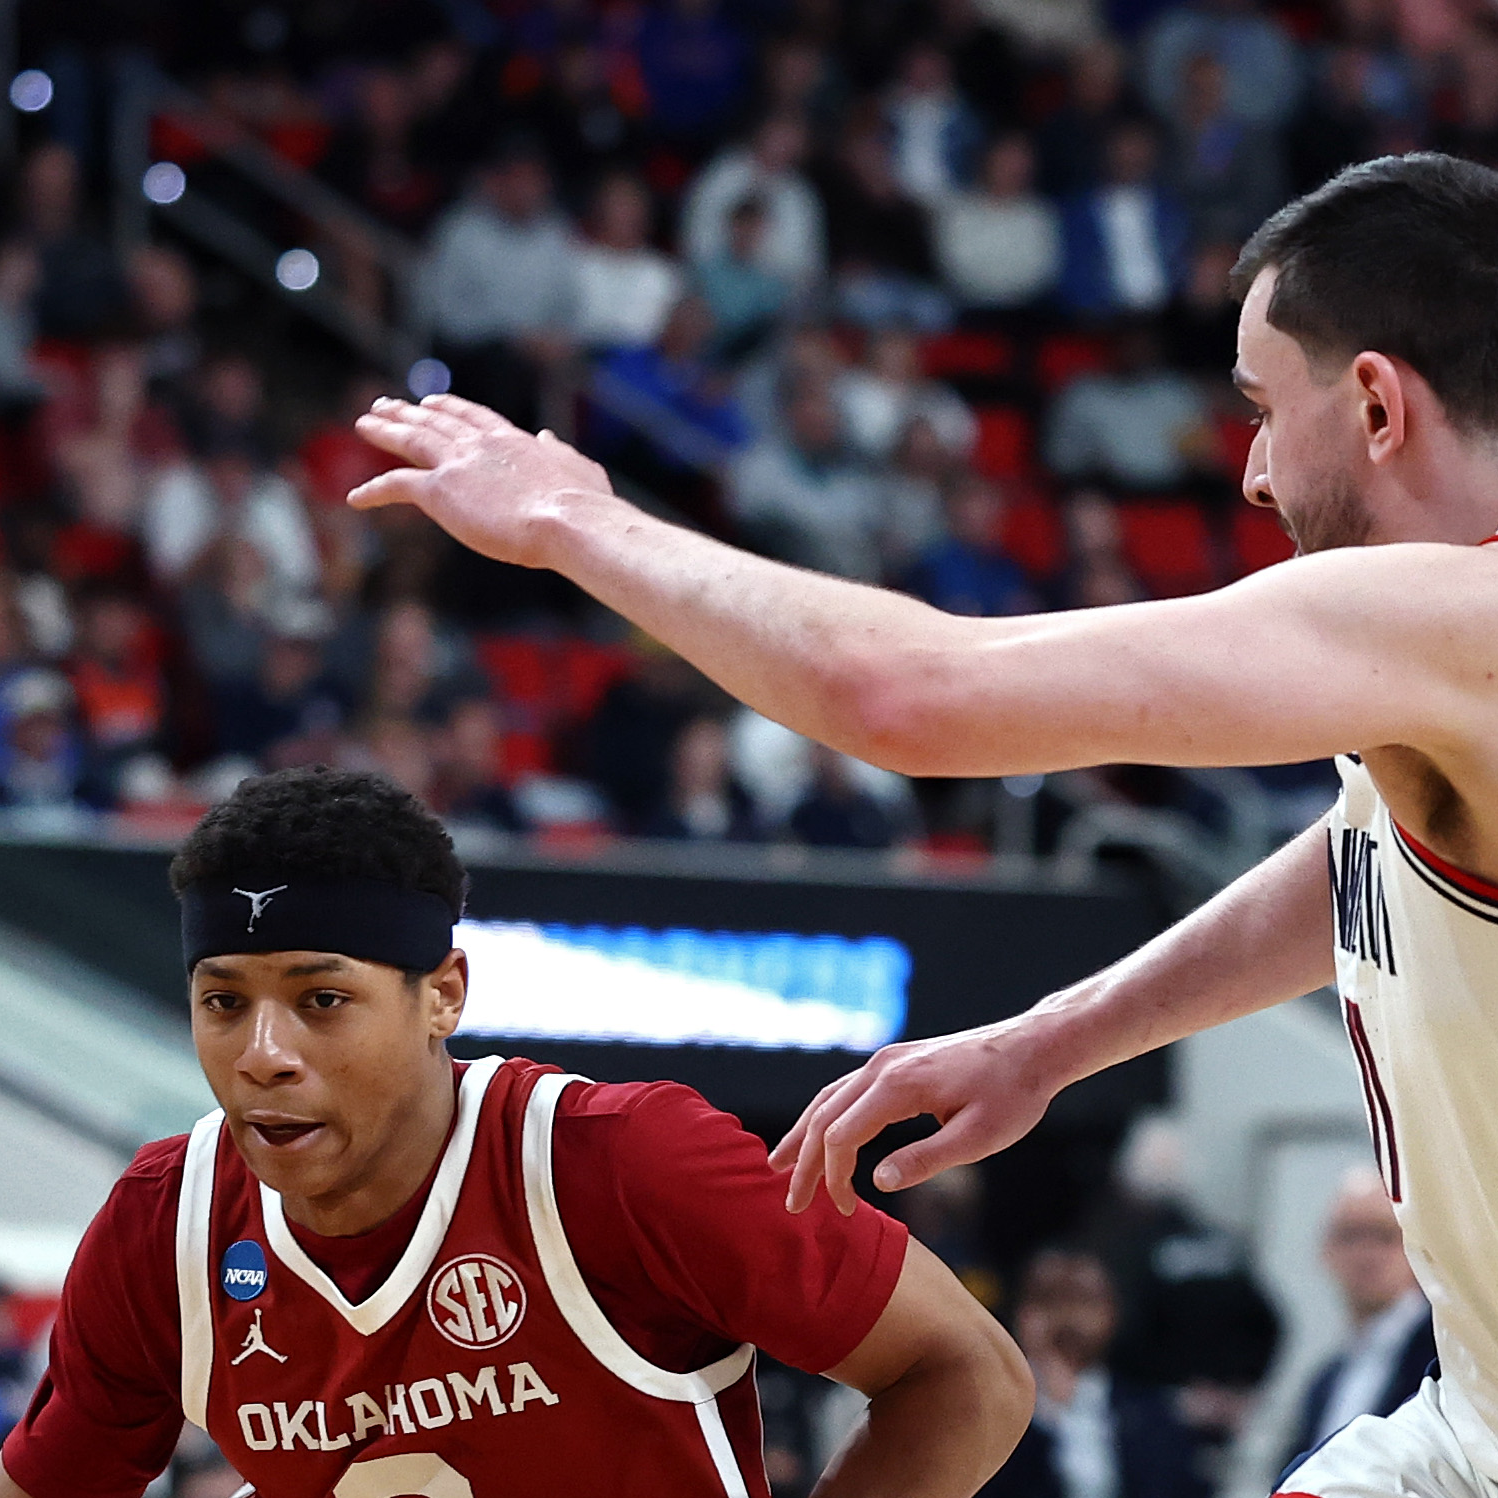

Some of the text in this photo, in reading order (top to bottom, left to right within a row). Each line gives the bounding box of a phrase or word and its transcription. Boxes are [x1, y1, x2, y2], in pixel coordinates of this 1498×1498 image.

[225, 1268, 266, 1286] NCAA
[435, 1262, 518, 1342] SEC
[237, 1361, 559, 1451] OKLAHOMA
